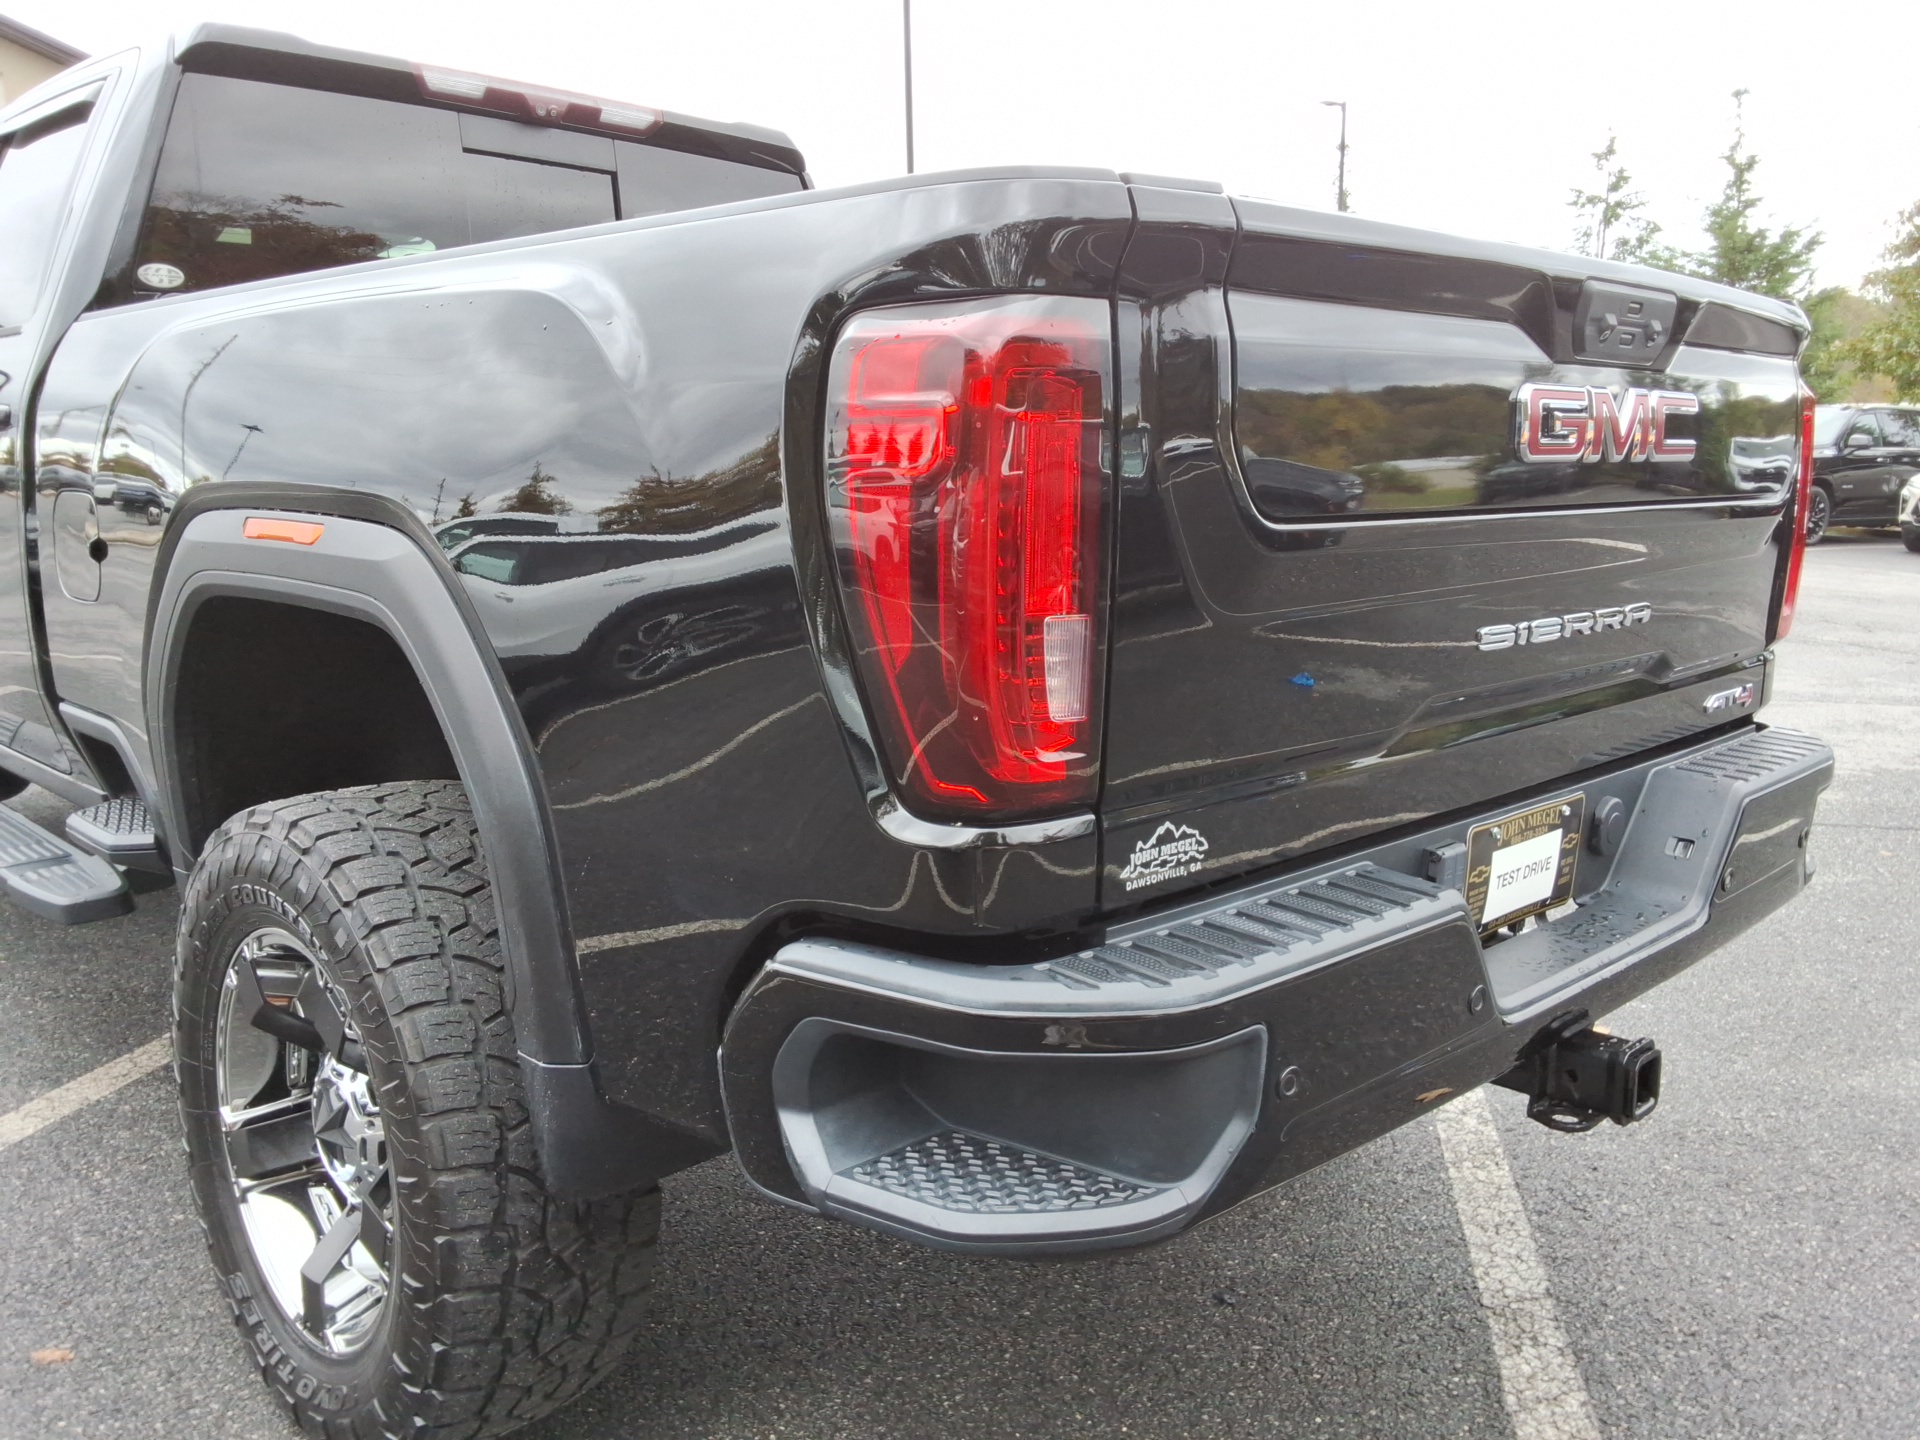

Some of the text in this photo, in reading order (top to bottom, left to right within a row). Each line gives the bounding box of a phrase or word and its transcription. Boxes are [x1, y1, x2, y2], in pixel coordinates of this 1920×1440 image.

[1511, 382, 1698, 463] GMC
[1476, 602, 1651, 651] SIERRA
[1703, 683, 1753, 713] AT4
[1498, 808, 1560, 846] JOHN MEGEL
[1130, 838, 1198, 871] JOHN MEGEL
[1126, 861, 1202, 891] DAWSONVILLE, GA
[1497, 868, 1522, 889] TEST
[1523, 856, 1552, 880] DRIVE
[226, 1271, 299, 1384] TIRES
